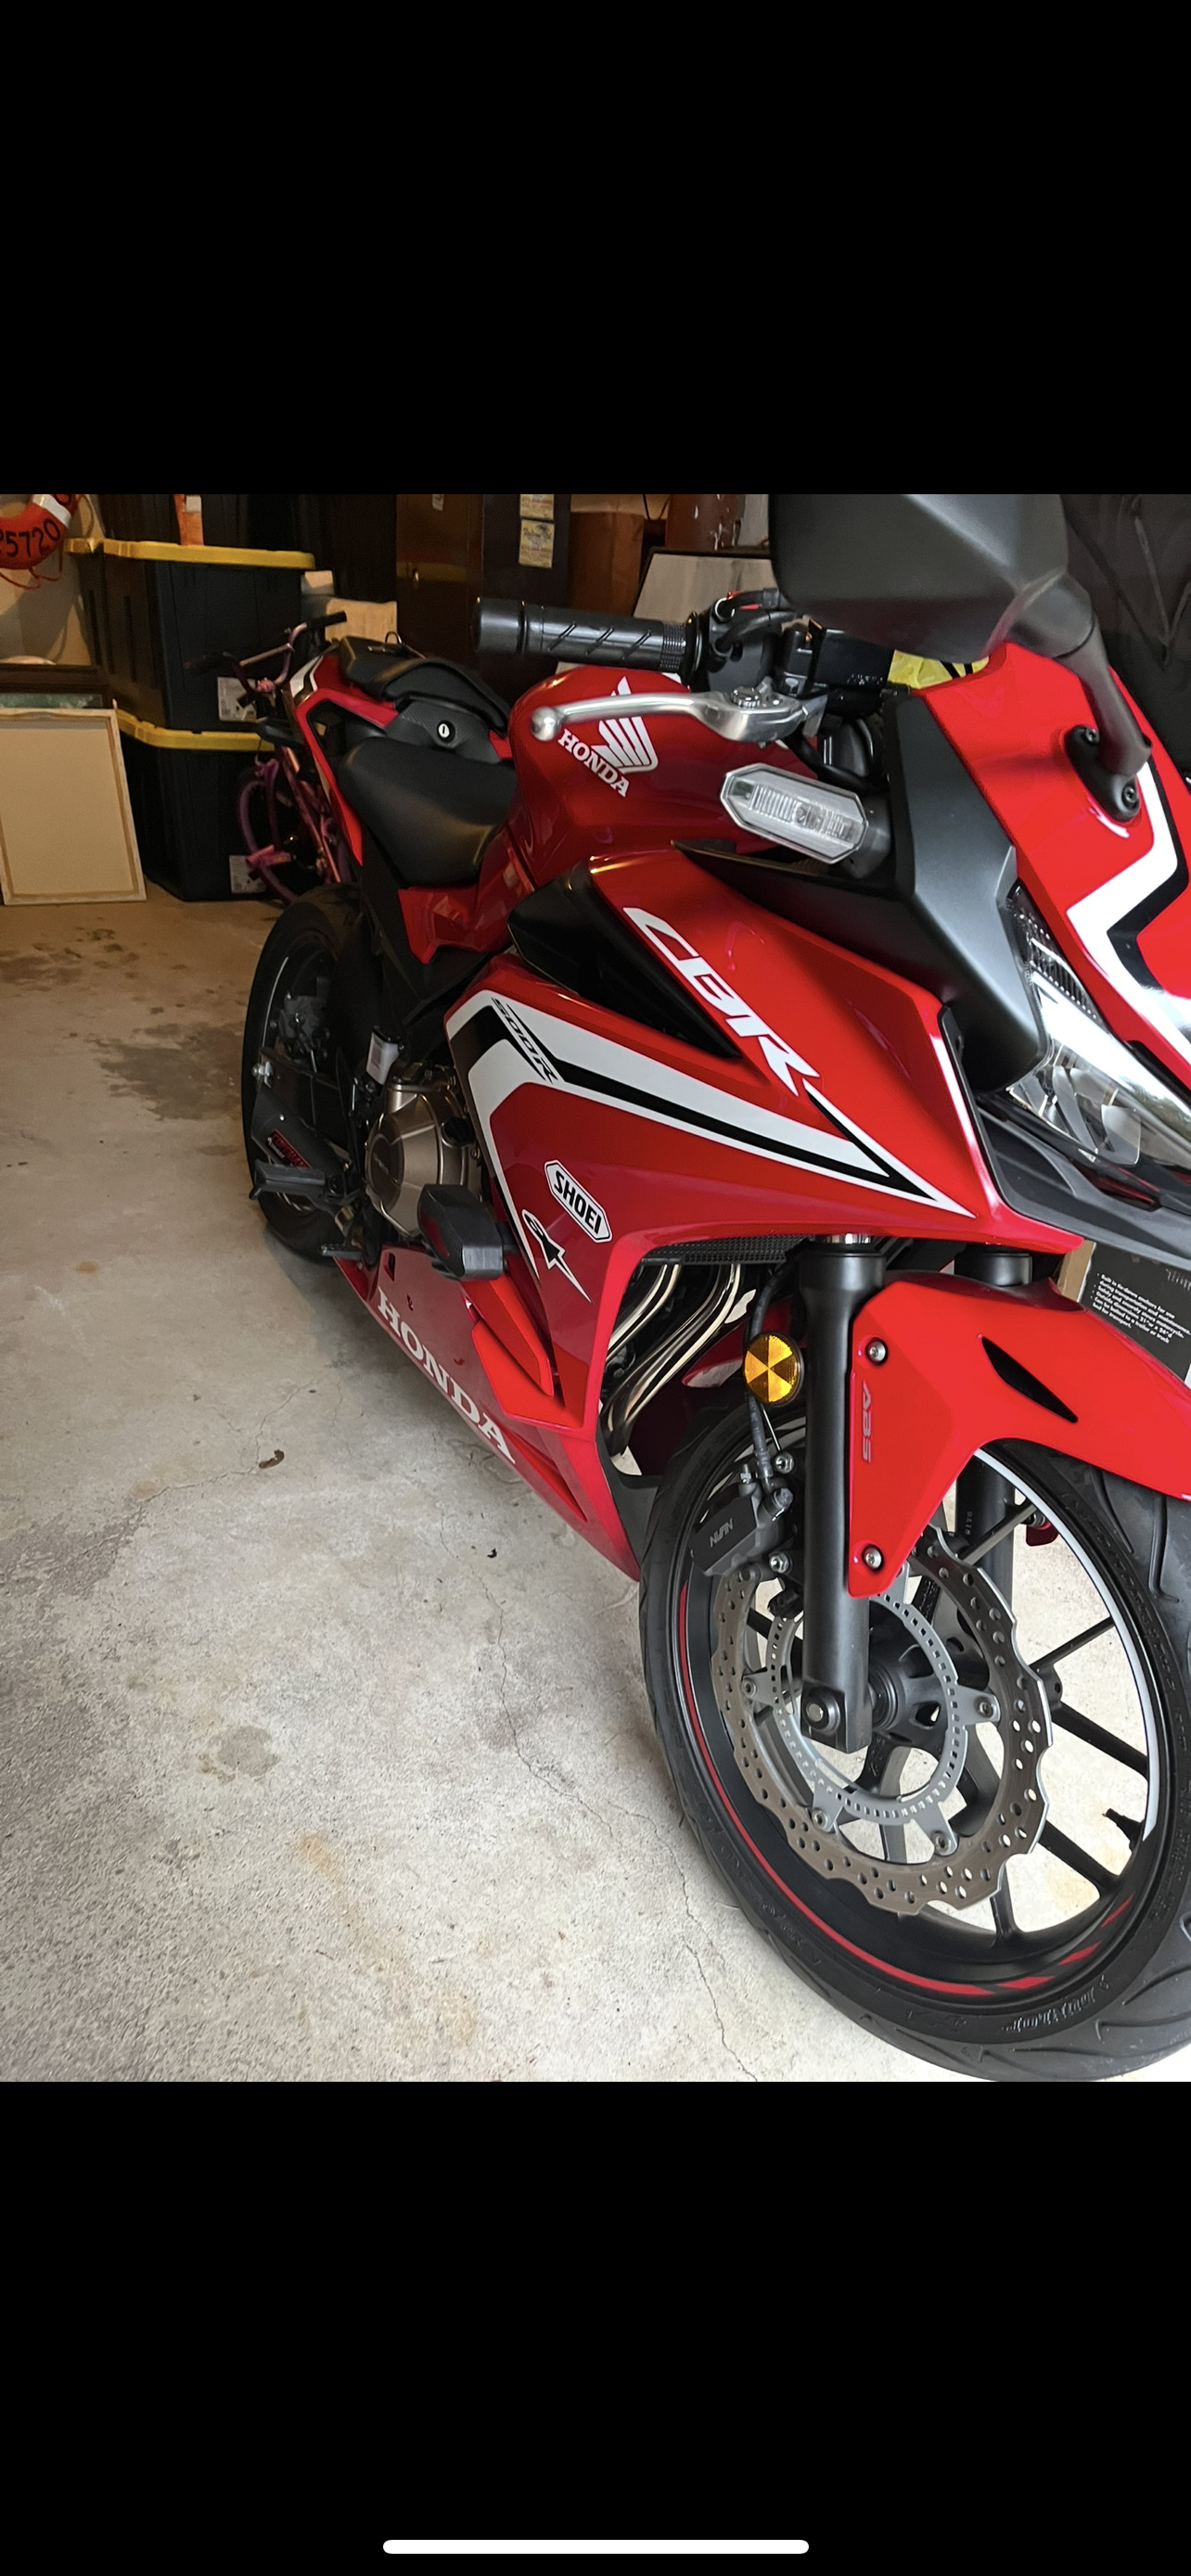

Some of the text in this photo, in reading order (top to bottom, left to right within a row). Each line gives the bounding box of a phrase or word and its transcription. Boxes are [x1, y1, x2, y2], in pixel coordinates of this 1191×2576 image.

[557, 728, 630, 797] HONDA
[491, 997, 558, 1084] 500R
[622, 907, 820, 1096] CBR
[554, 1170, 602, 1234] SHOEI
[378, 1287, 516, 1465] HONDA
[863, 1379, 872, 1463] ABS
